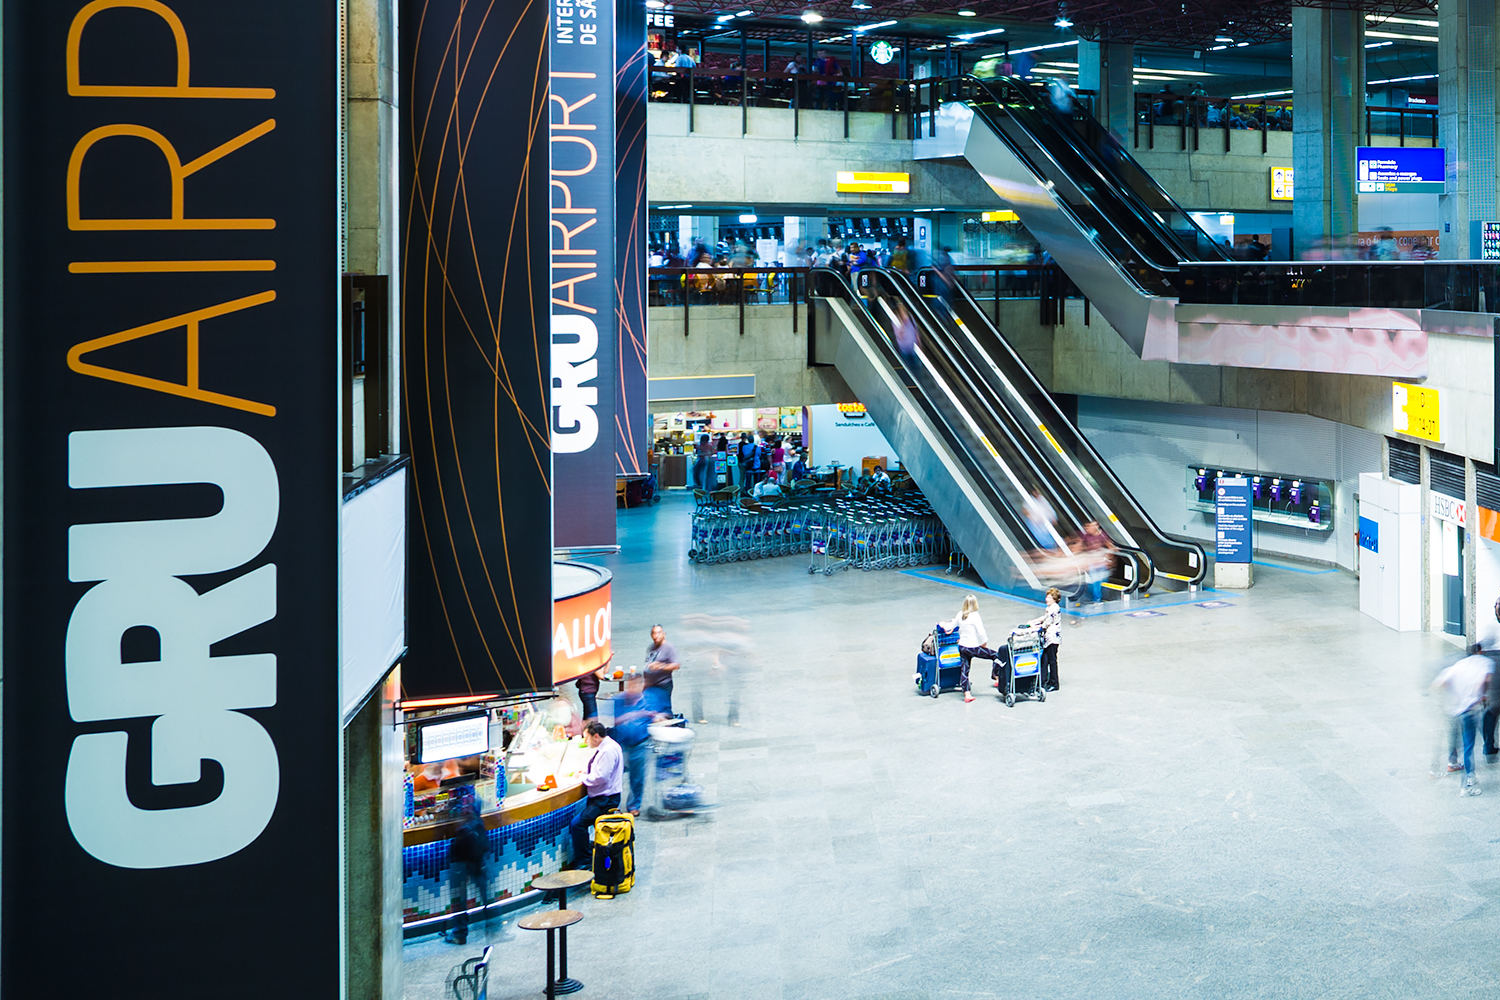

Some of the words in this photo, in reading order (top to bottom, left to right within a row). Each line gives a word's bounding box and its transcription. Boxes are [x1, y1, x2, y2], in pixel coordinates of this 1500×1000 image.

[579, 23, 597, 45] DE
[835, 401, 868, 413] toste
[1420, 392, 1426, 408] D
[1434, 495, 1456, 520] HSBC
